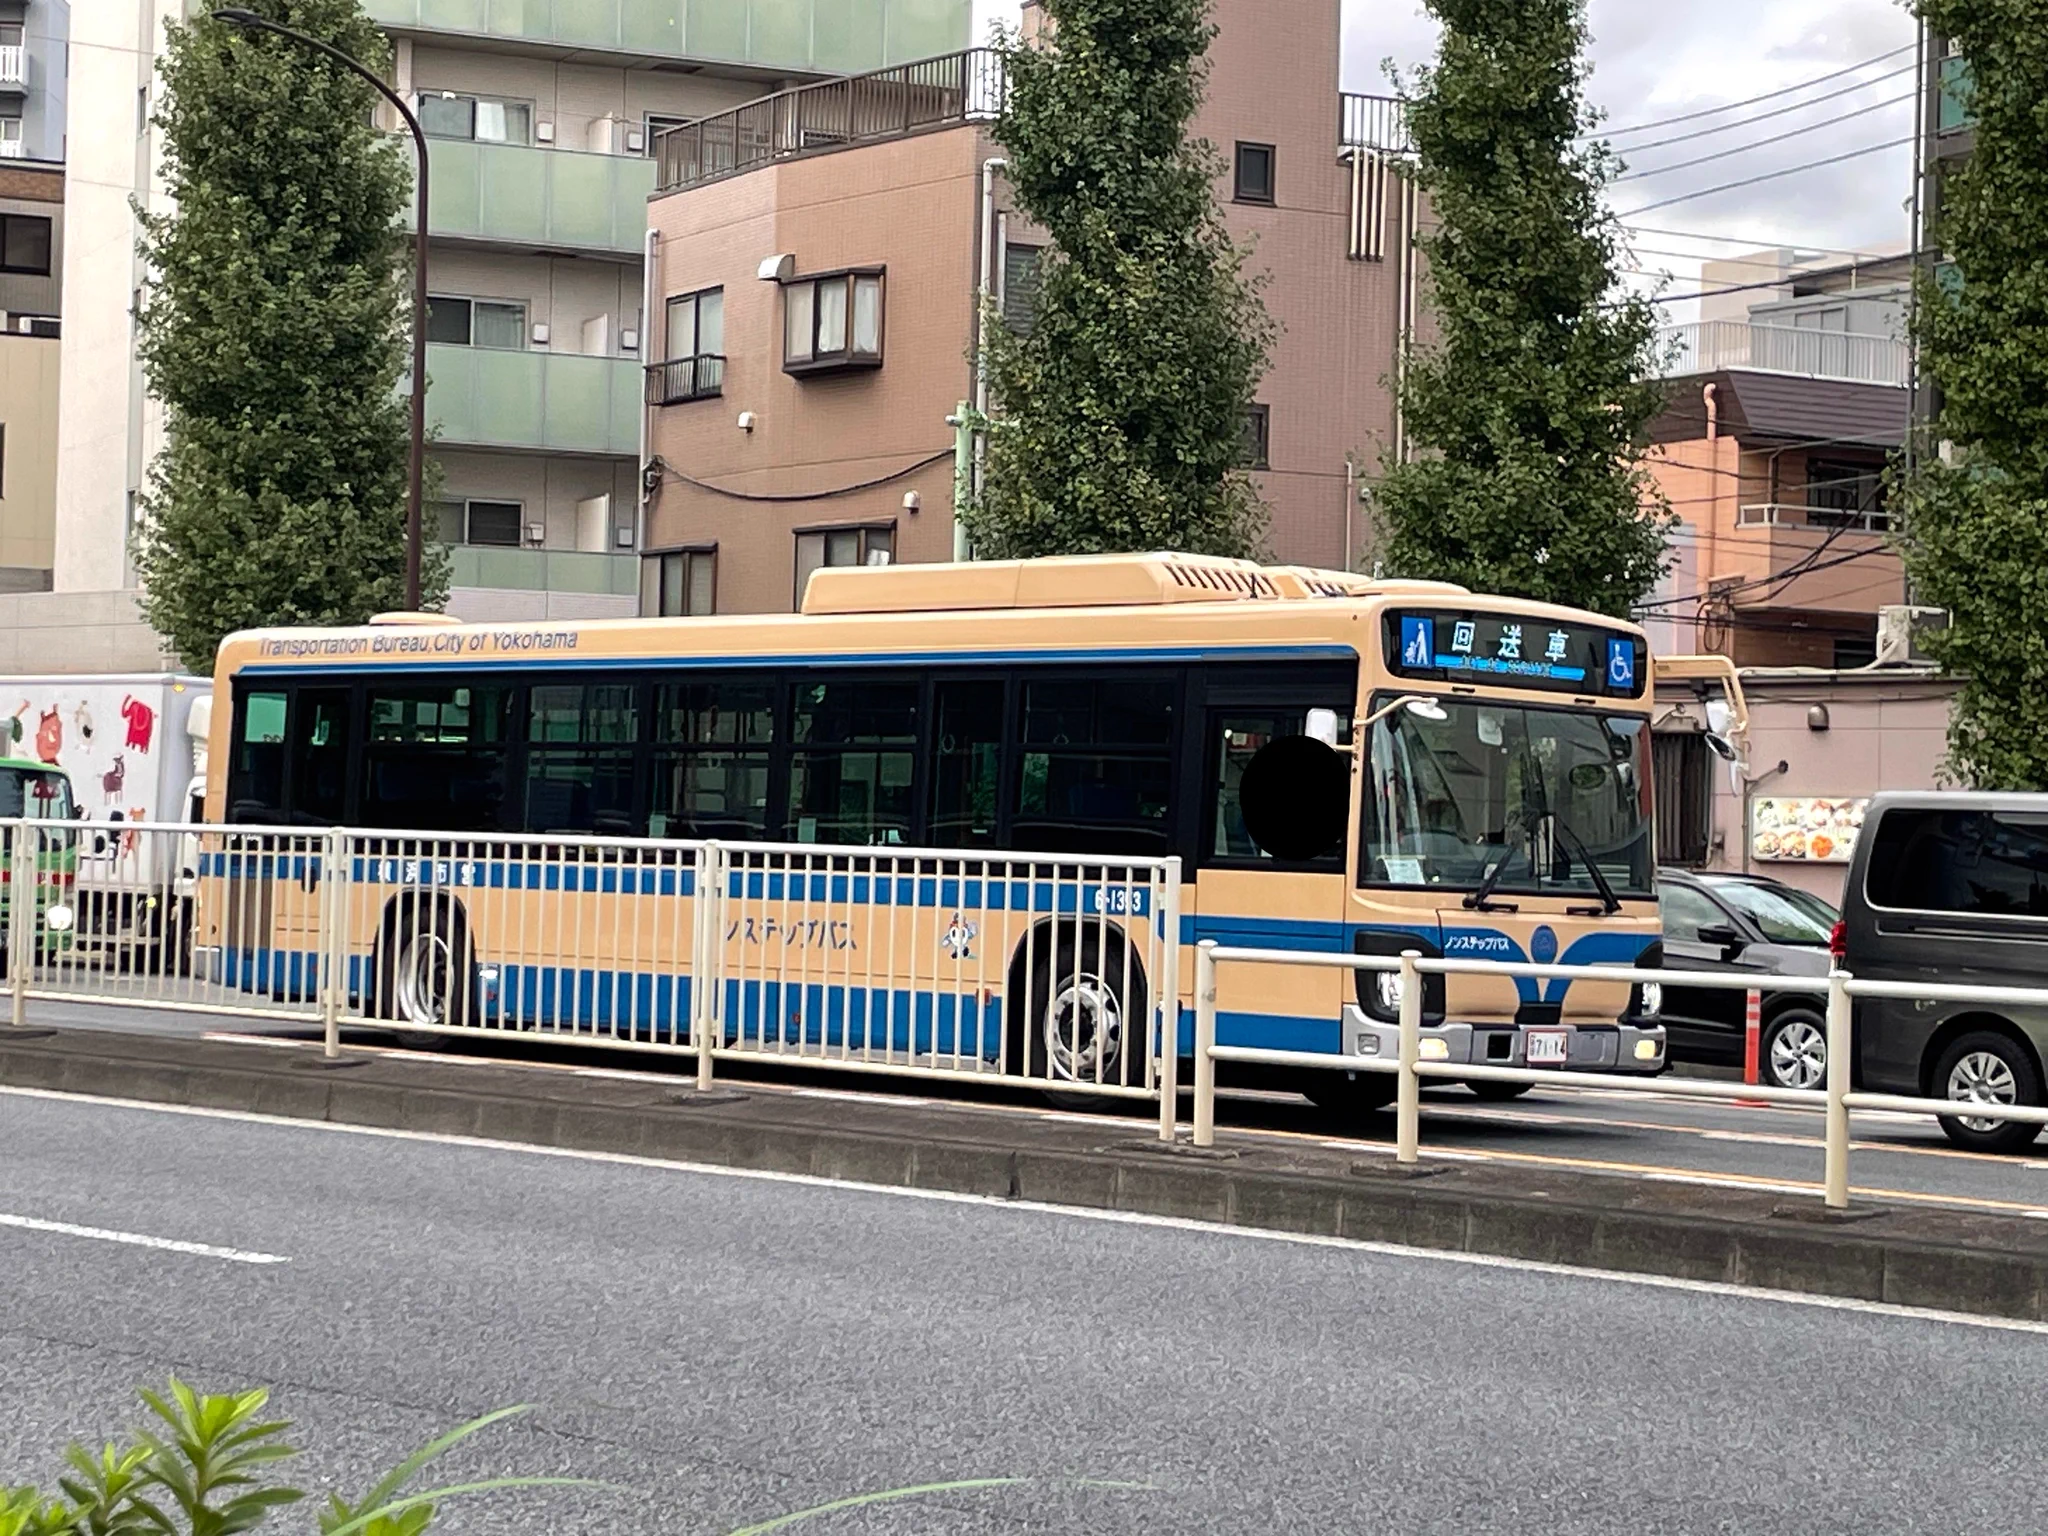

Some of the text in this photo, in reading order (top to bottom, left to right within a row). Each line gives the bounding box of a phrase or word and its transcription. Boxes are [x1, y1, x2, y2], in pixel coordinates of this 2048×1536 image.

[260, 637, 368, 658] Transportation
[469, 632, 489, 651] of
[493, 630, 578, 650] Yokohama
[1452, 621, 1570, 662] 回送車
[1094, 889, 1142, 912] 6-133
